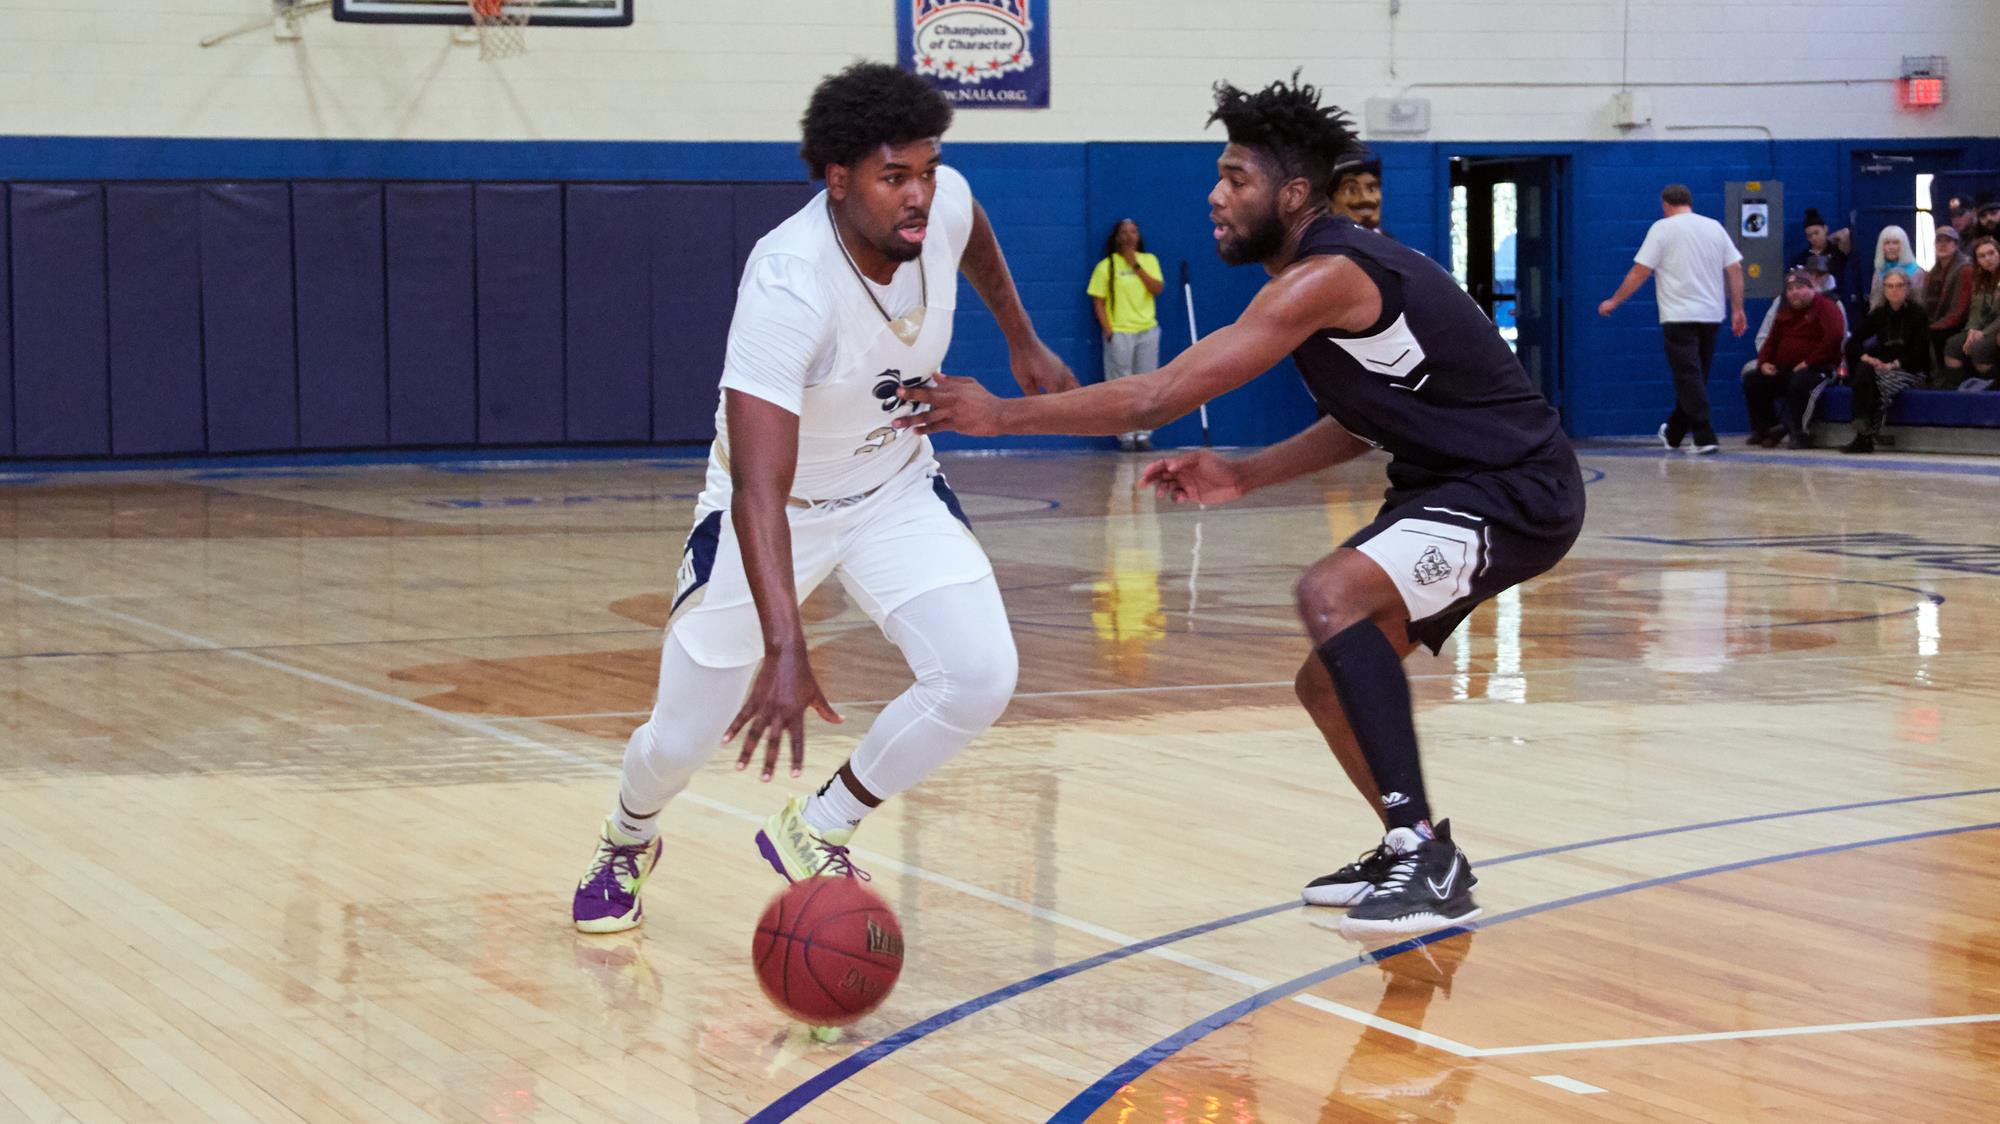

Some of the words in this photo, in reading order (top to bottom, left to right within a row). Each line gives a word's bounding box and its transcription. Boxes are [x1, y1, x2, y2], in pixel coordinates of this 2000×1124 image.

[934, 25, 1007, 37] Champions
[929, 40, 943, 50] of
[948, 39, 1013, 50] Character
